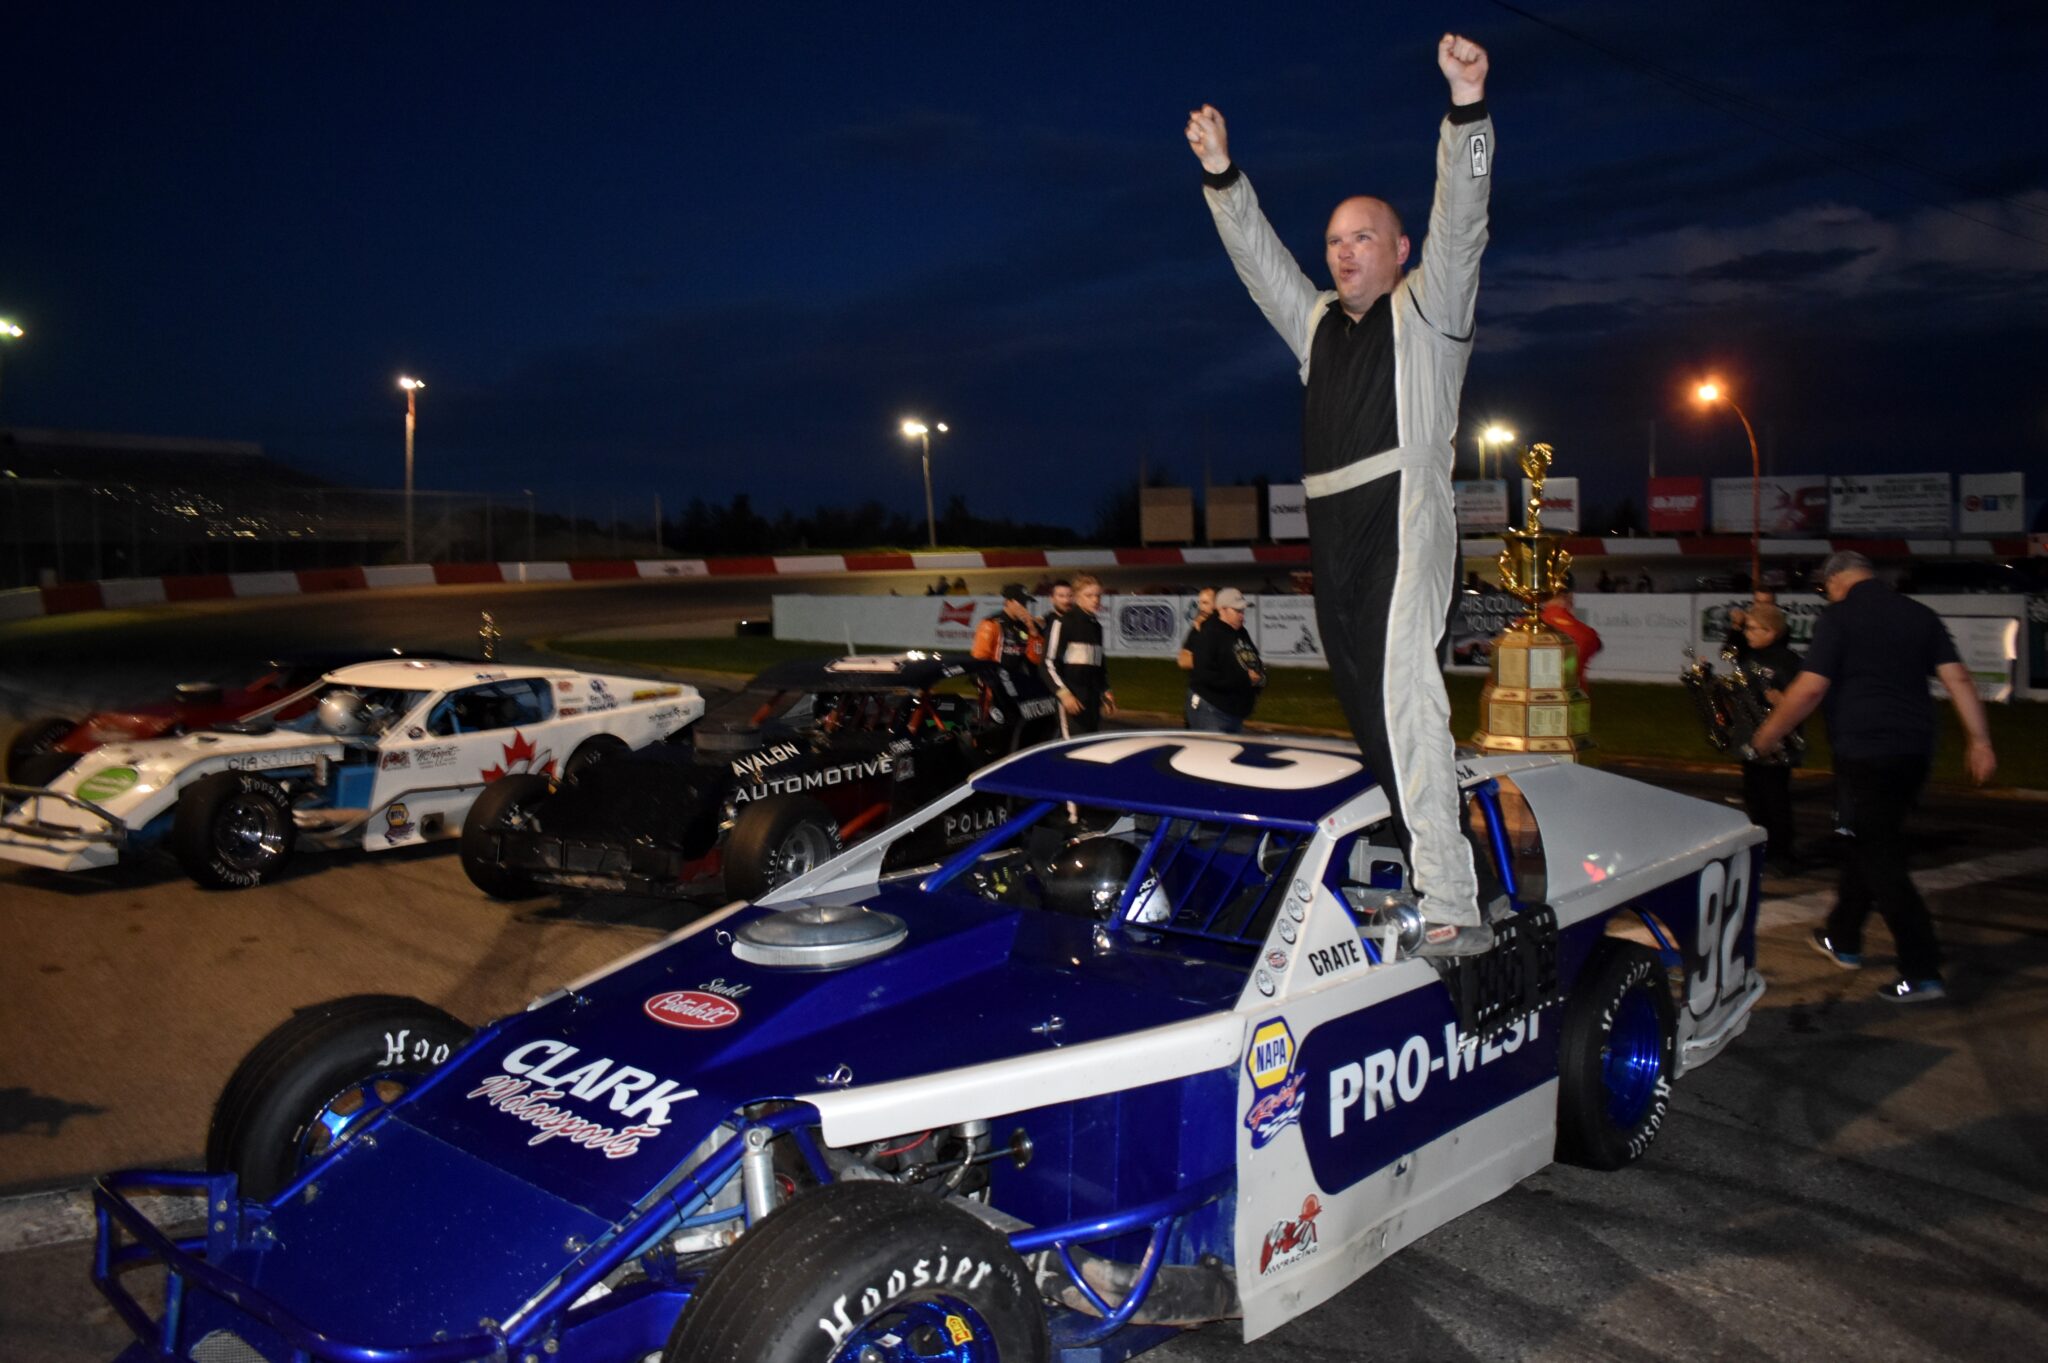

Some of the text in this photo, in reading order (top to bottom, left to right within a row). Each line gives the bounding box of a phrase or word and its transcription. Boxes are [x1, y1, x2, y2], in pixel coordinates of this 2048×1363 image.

[732, 742, 801, 777] AVALON
[735, 758, 894, 803] AUTOMOTIVE
[946, 808, 1008, 836] POLAR
[1688, 851, 1751, 1022] 92
[1308, 939, 1361, 977] CRATE
[652, 993, 736, 1023] Peterbilt
[1256, 1035, 1288, 1074] NAPA
[502, 1039, 699, 1127] CLARK
[466, 1075, 661, 1159] Motorsports
[819, 1244, 993, 1346] Hoosier
